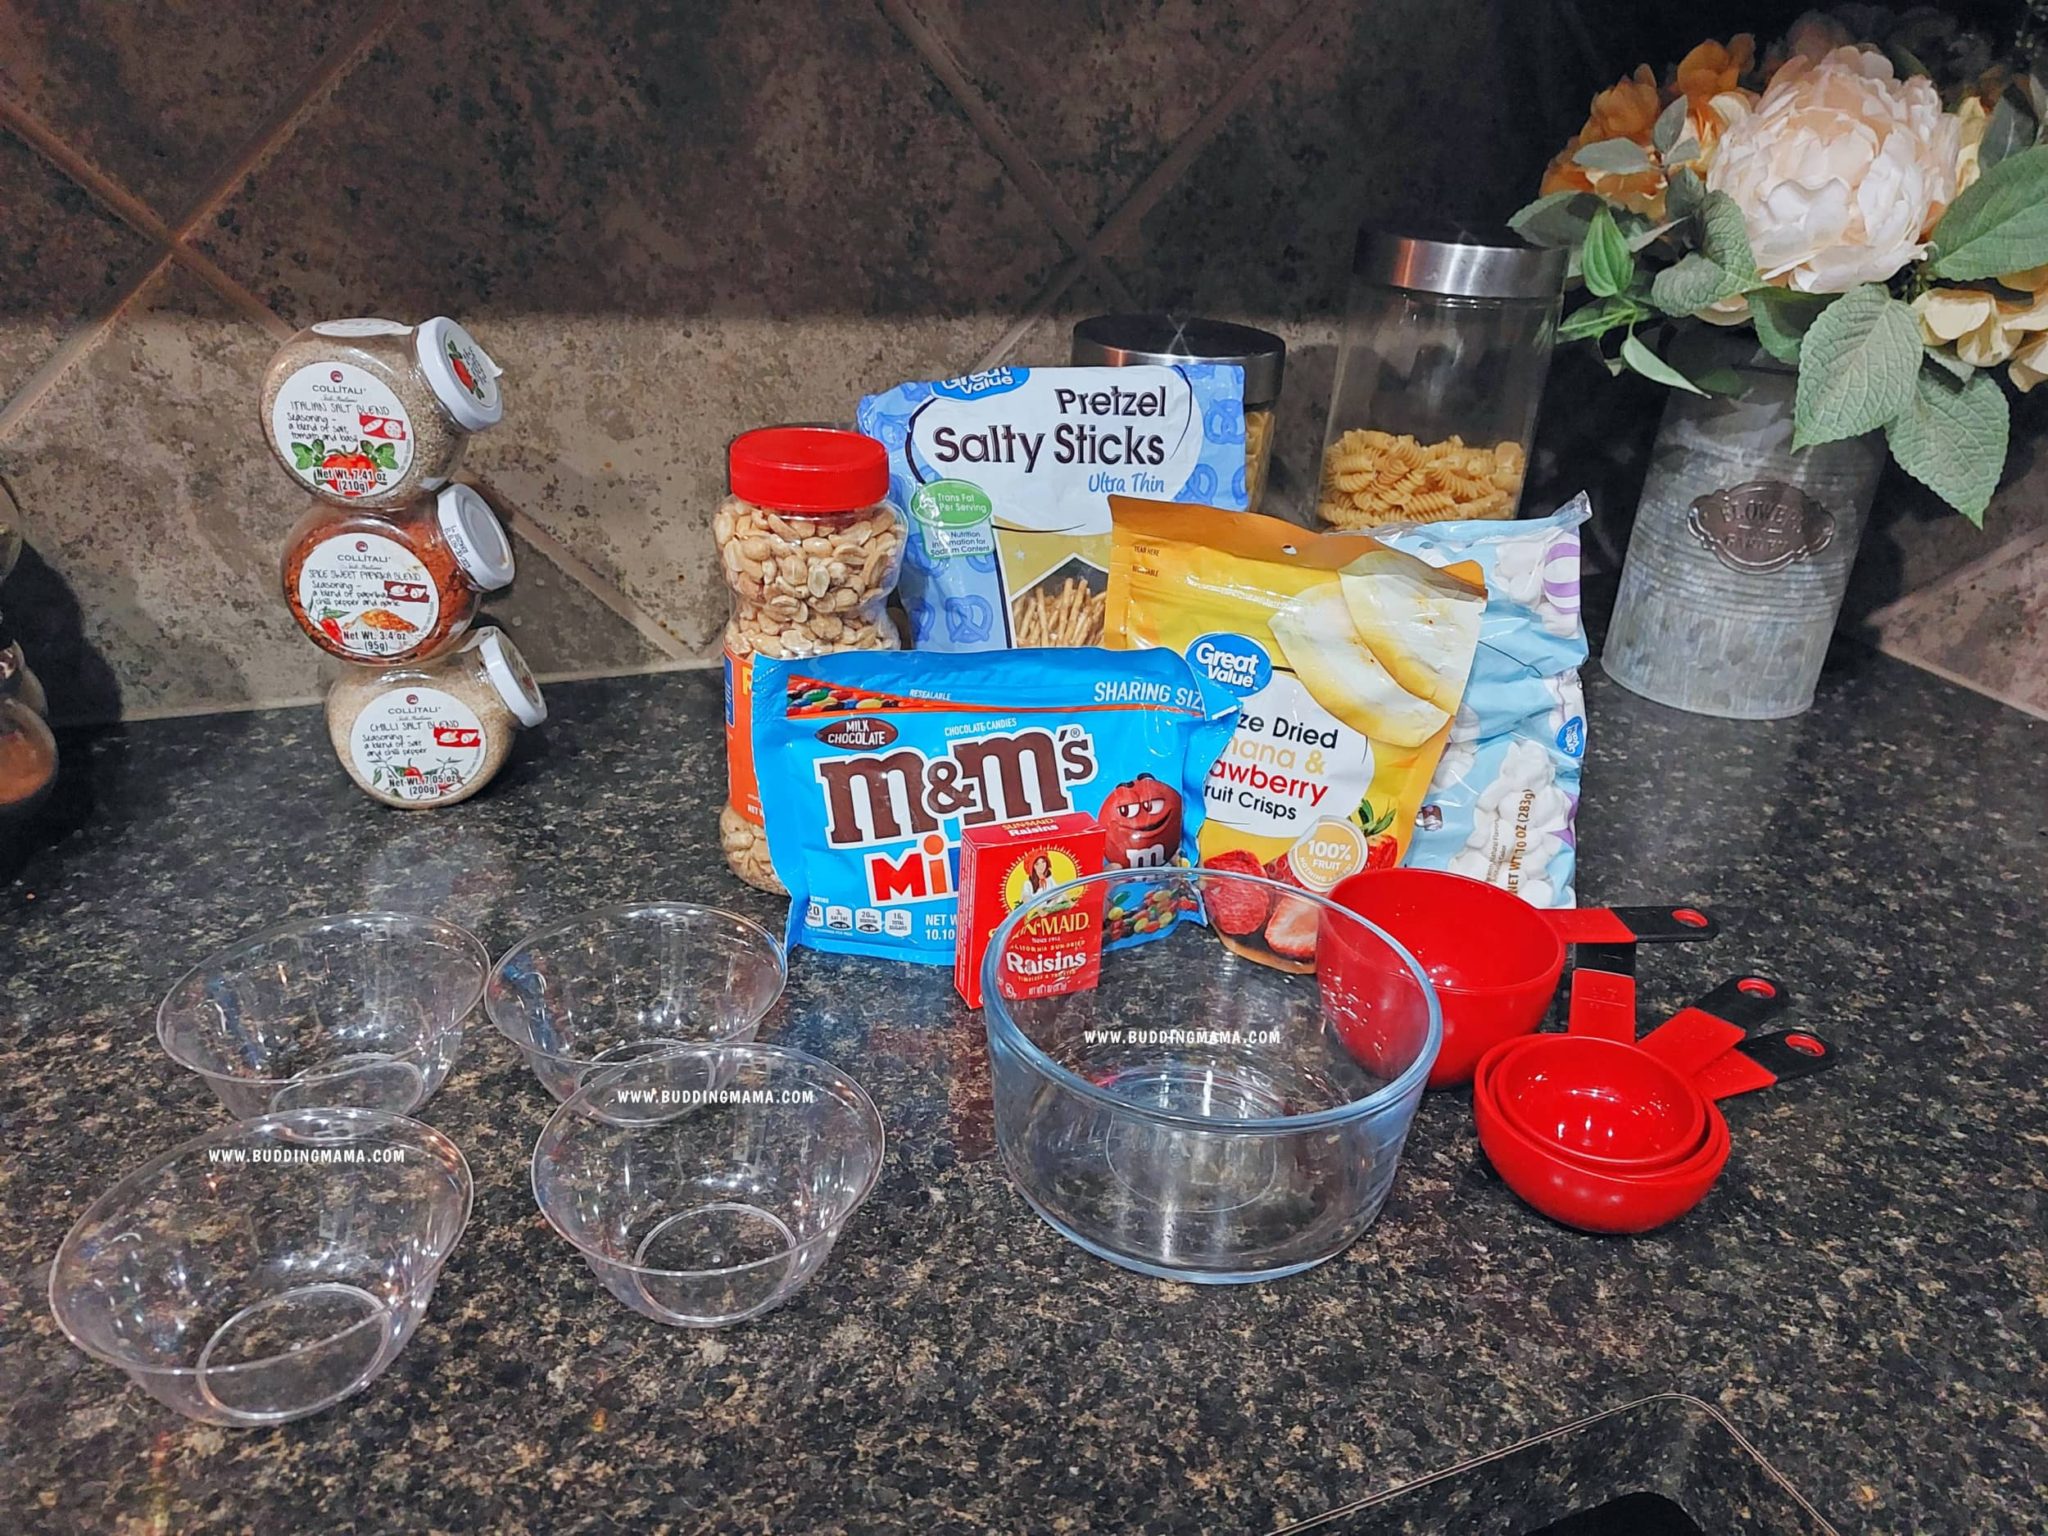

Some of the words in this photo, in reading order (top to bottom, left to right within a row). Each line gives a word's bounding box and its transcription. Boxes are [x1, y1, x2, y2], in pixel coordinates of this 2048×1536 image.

[960, 375, 1014, 394] Value
[331, 403, 351, 413] SALT
[356, 404, 390, 416] BLEND
[1054, 385, 1166, 417] Pretzel
[933, 424, 1046, 473] Salty
[1053, 423, 1165, 465] Sticks
[339, 481, 368, 493] (210g)
[1088, 472, 1126, 493] Ultra
[1131, 472, 1165, 493] Thin
[954, 503, 987, 513] Serving
[364, 641, 389, 652] (95g)
[1195, 642, 1260, 675] Great
[1207, 664, 1254, 688] Value
[909, 689, 951, 701] RESEALABLE
[1094, 681, 1172, 703] SHARING
[1175, 687, 1204, 709] SIZ
[402, 721, 422, 731] SALT
[845, 719, 870, 733] MILK
[944, 722, 985, 737] CHOCOLATE
[985, 717, 1017, 731] CANDIES
[1272, 717, 1338, 749] Dried
[827, 731, 886, 746] CHOCOLATE
[1304, 750, 1326, 776] &
[409, 785, 438, 796] (200g)
[1209, 759, 1328, 807] awberry
[1204, 784, 1233, 803] ruit
[1238, 791, 1297, 821] Crisps
[1517, 789, 1535, 823] (283g)
[1008, 824, 1059, 837] Raisins
[1516, 825, 1527, 838] OZ
[1308, 840, 1351, 861] 100%
[1515, 841, 1527, 852] 10
[1312, 859, 1342, 870] FRUIT
[1509, 856, 1522, 871] WT
[1508, 873, 1519, 894] NET
[925, 914, 947, 926] NET
[1010, 944, 1047, 953] ALIFORNIA
[1006, 951, 1087, 975] Raisins
